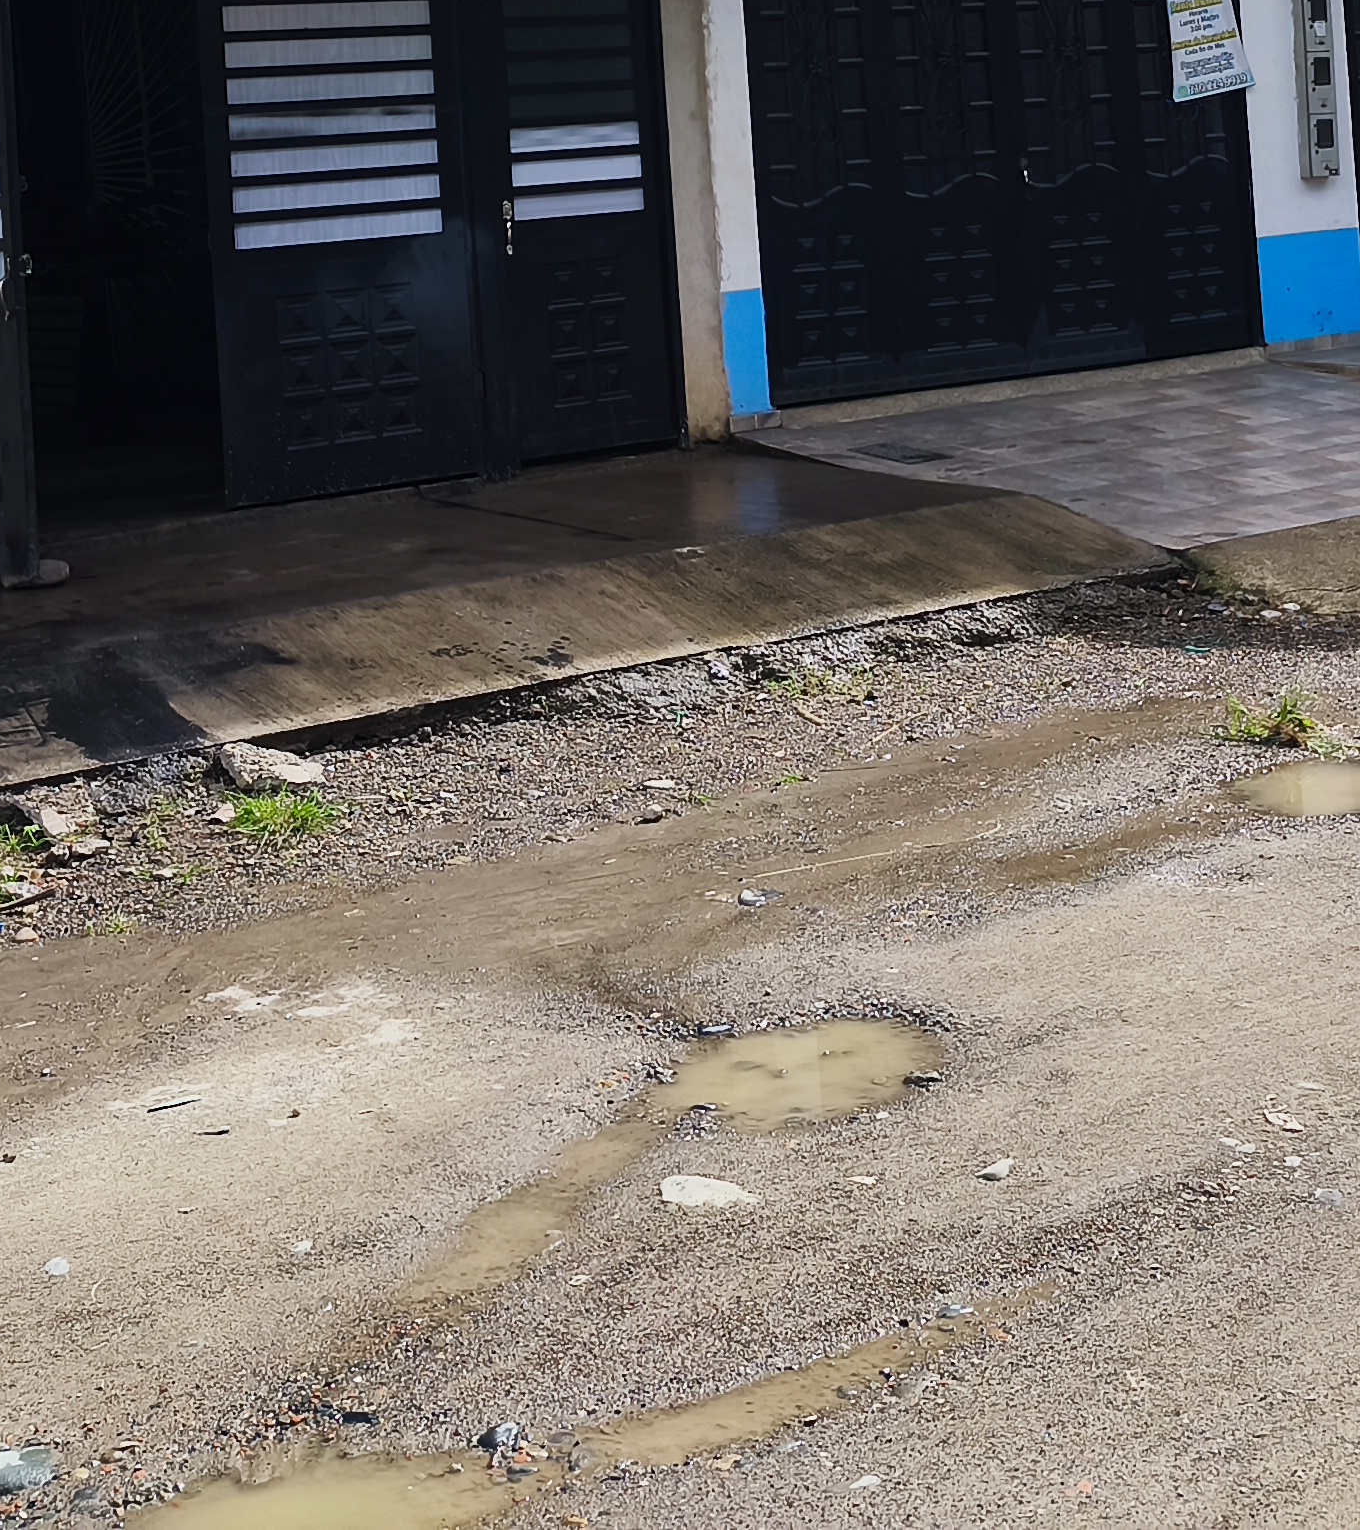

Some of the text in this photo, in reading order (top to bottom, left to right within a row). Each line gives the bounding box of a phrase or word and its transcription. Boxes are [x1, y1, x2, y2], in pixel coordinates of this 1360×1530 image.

[1179, 18, 1196, 27] Lunes
[1200, 14, 1220, 23] Martes
[1184, 48, 1198, 56] Cada
